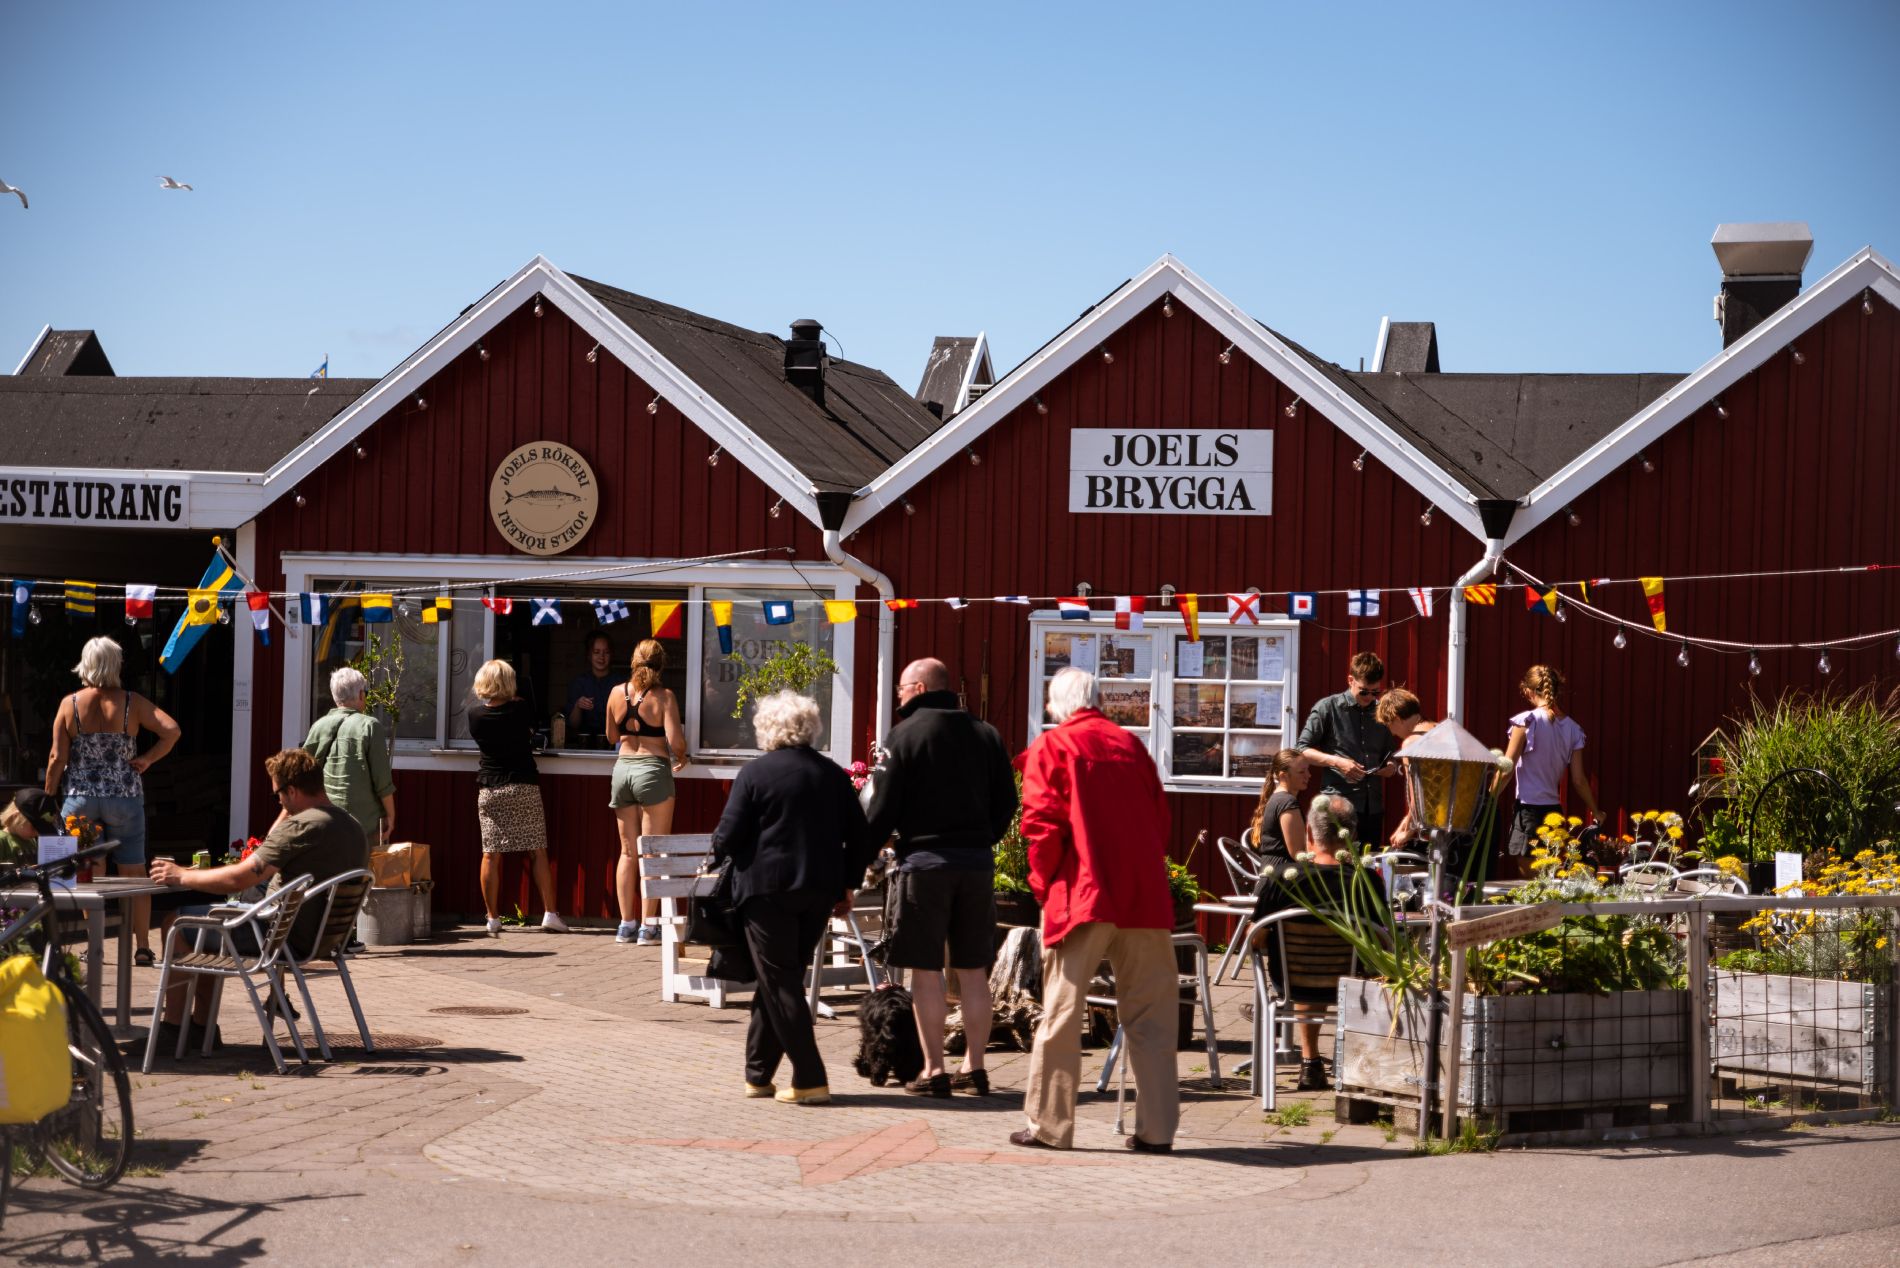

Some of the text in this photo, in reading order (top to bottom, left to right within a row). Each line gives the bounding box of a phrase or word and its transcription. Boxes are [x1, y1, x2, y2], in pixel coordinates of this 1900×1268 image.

[500, 447, 590, 488] JOELS RÖKERI
[1103, 433, 1239, 467] JOELS
[1085, 475, 1256, 510] BRYGGA
[497, 510, 588, 550] JOELS RÖKERI
